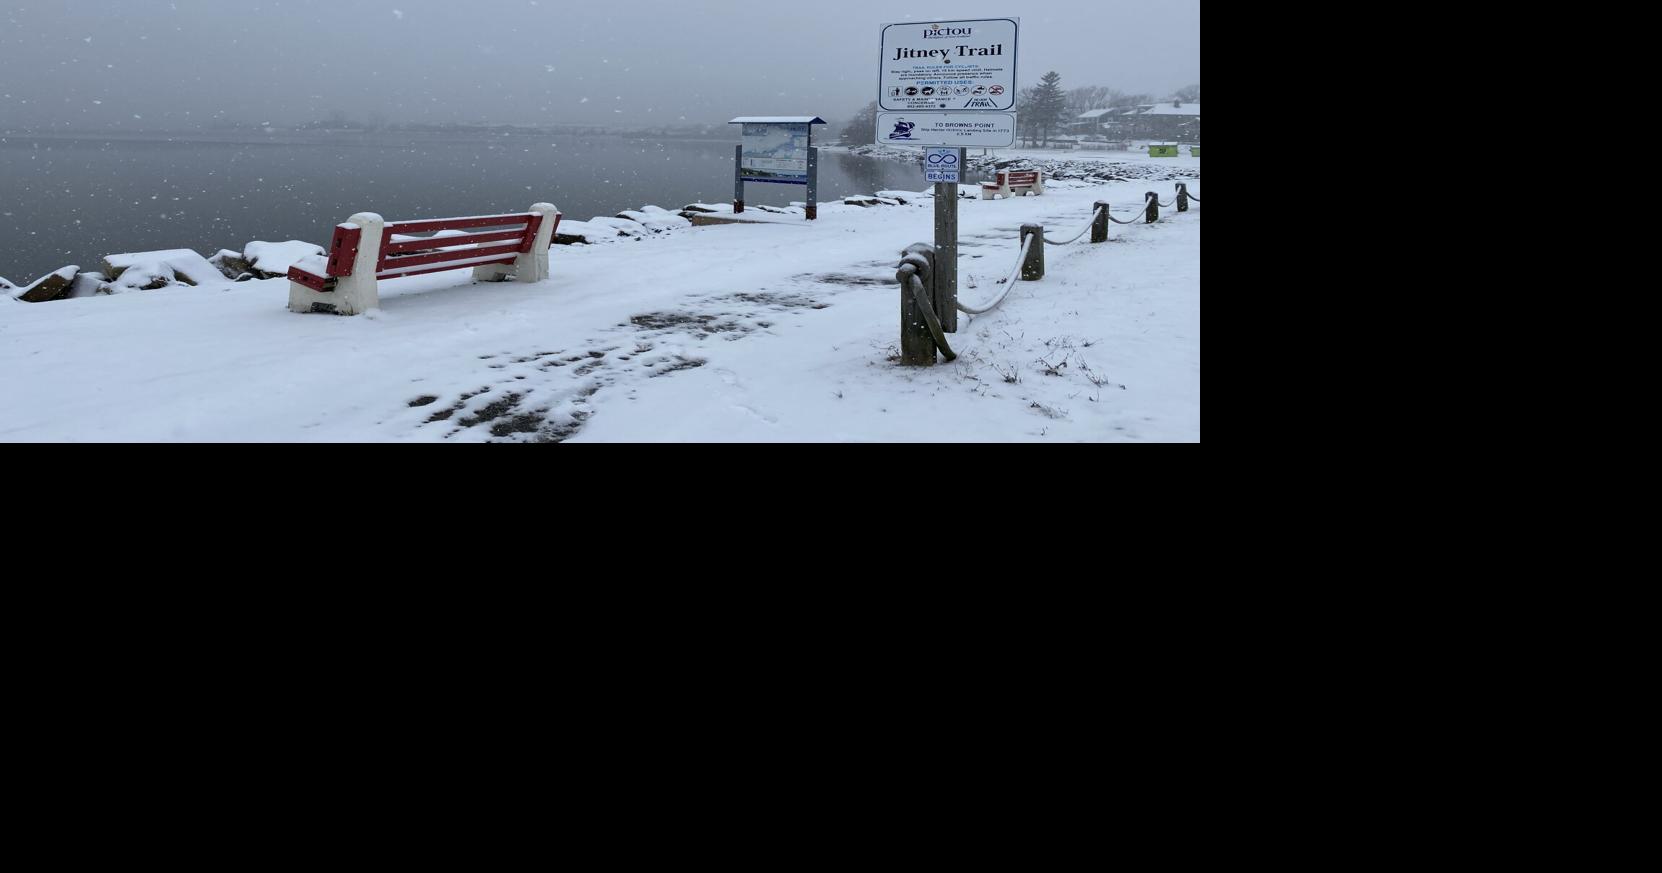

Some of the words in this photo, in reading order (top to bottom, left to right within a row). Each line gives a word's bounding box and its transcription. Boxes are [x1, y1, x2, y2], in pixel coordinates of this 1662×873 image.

[923, 26, 972, 38] pictou
[893, 47, 950, 60] Jitney
[956, 44, 1002, 56] Trail
